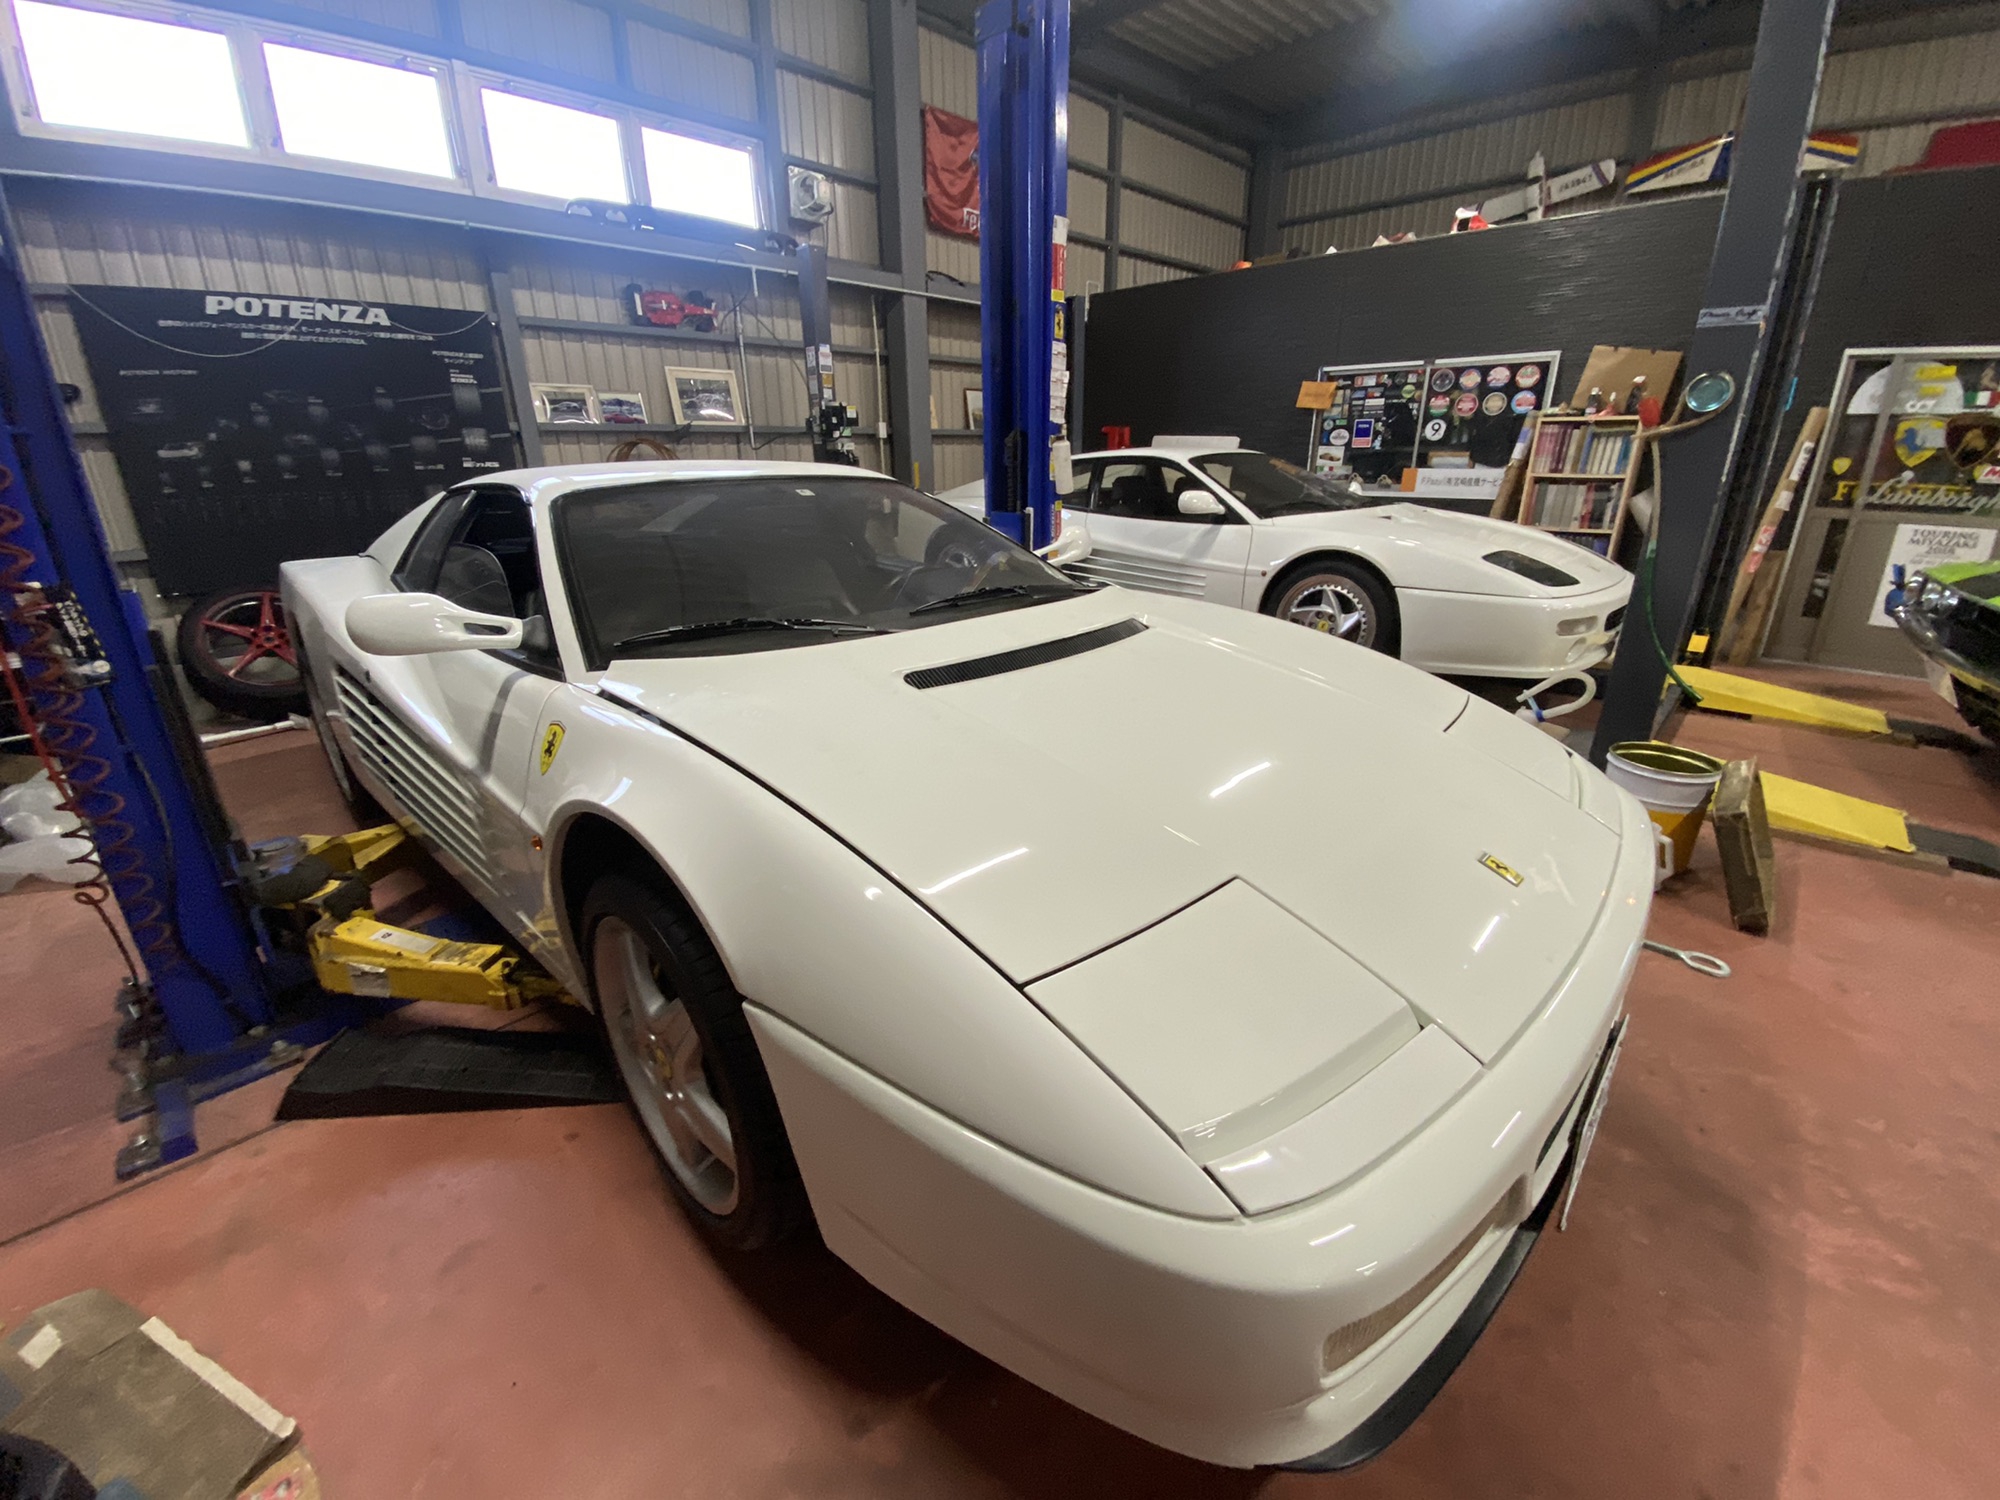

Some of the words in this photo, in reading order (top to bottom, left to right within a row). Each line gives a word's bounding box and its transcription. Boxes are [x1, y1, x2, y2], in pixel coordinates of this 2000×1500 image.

[205, 295, 392, 327] POTENZA
[1431, 421, 1442, 437] 9
[1912, 528, 1980, 542] TOURING
[1906, 537, 1979, 549] MIYAZAKI
